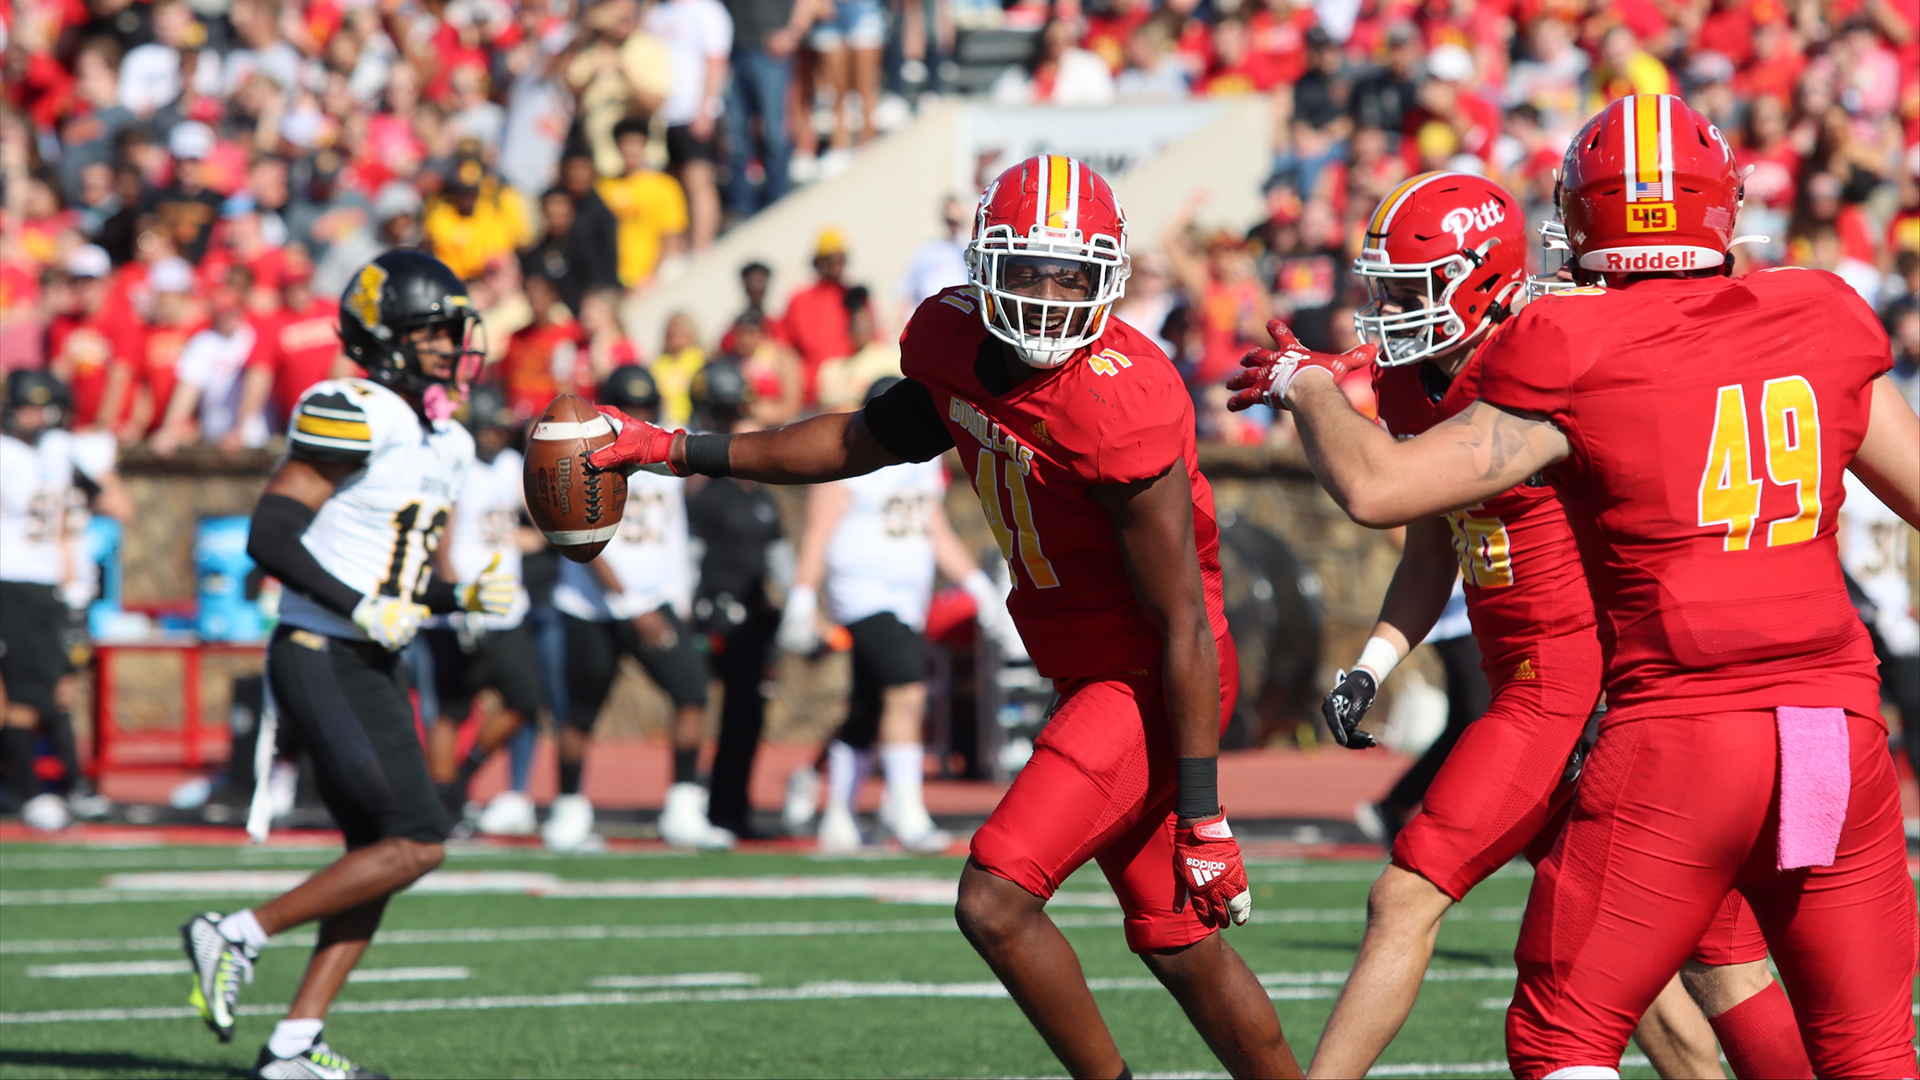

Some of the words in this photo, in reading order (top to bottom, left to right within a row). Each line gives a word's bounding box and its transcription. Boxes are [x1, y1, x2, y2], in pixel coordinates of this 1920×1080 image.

[1441, 199, 1505, 250] Pitt
[1631, 208, 1668, 229] 49
[1088, 348, 1132, 377] 41
[949, 395, 1034, 476] GORILLAS
[538, 467, 550, 507] GST
[557, 457, 572, 514] Wilson
[1698, 375, 1822, 551] 49
[976, 448, 1061, 591] 41
[1186, 857, 1226, 871] adidas
